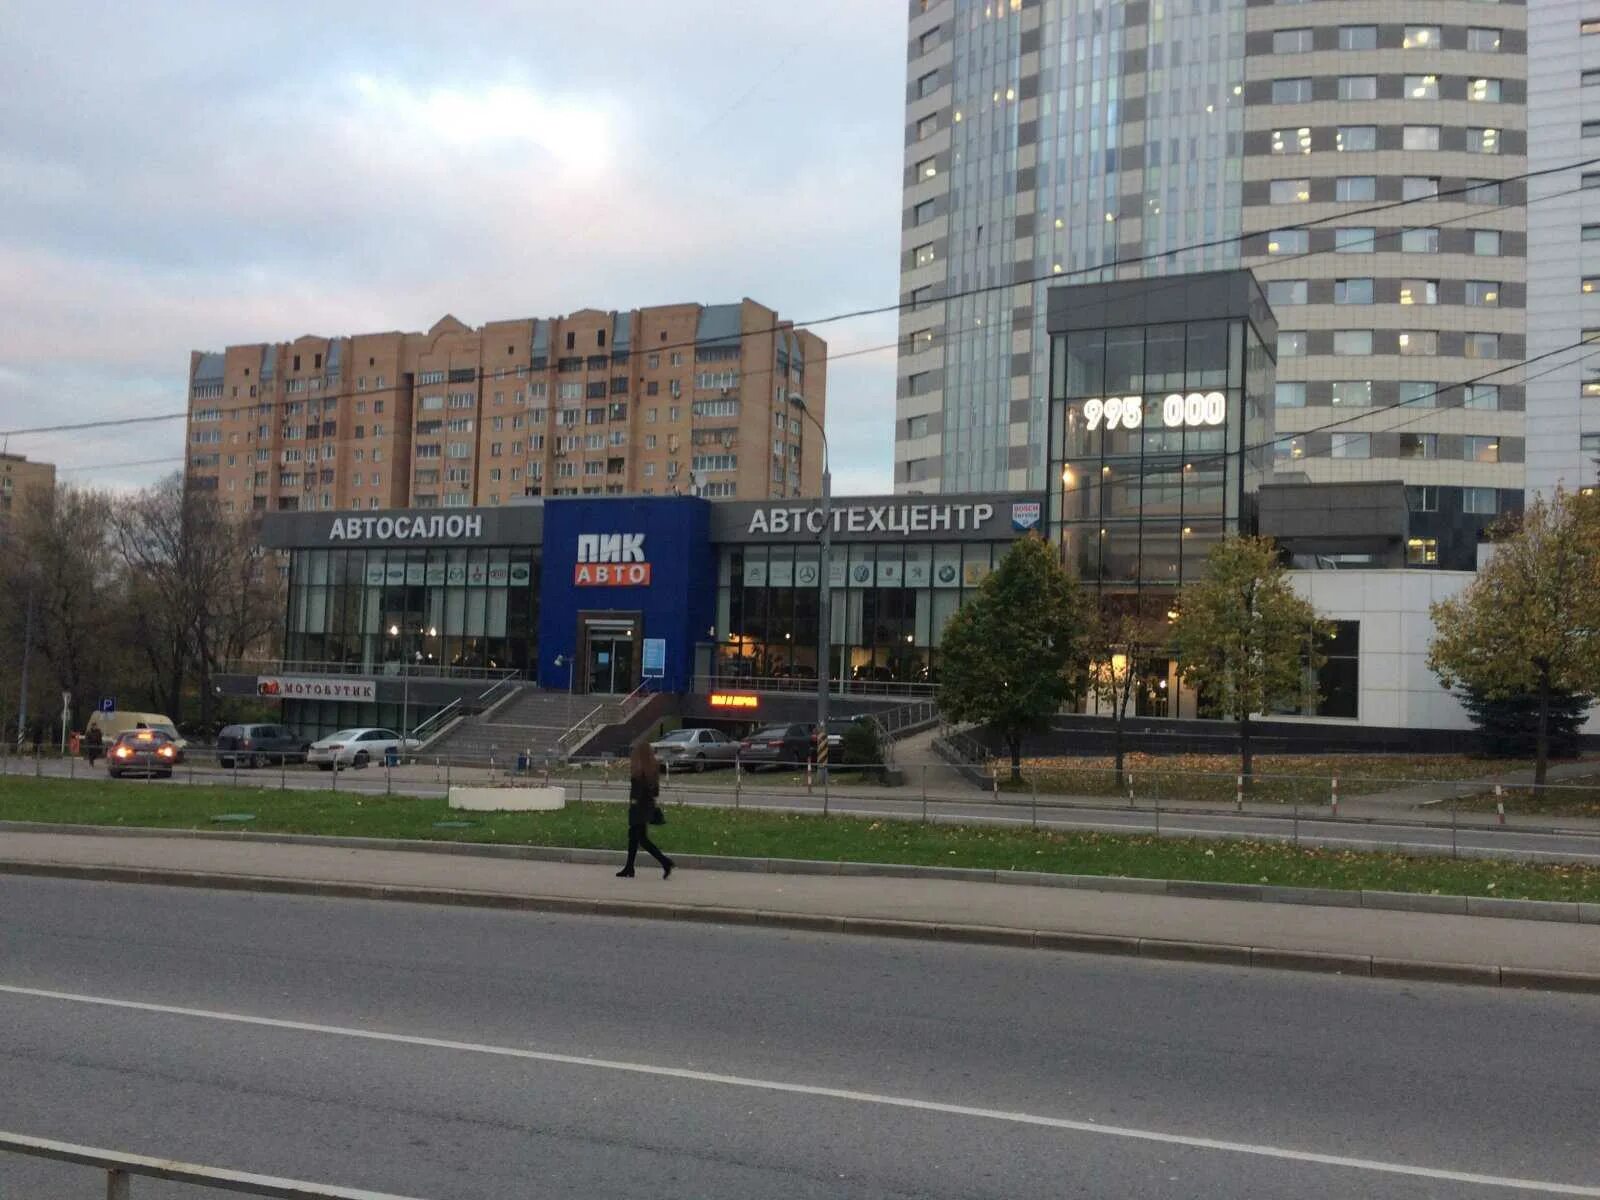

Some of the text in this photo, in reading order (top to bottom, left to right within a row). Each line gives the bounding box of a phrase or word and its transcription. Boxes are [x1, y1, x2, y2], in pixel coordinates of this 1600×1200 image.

[1163, 391, 1226, 427] 000
[329, 515, 482, 540] АВТОСАЛОН
[748, 503, 993, 535] АВТОТЕХЦЕНТР
[578, 533, 645, 562] ПИК
[577, 565, 646, 583] АВТО
[284, 682, 372, 697] МОТОБУТИК
[103, 699, 112, 710] P
